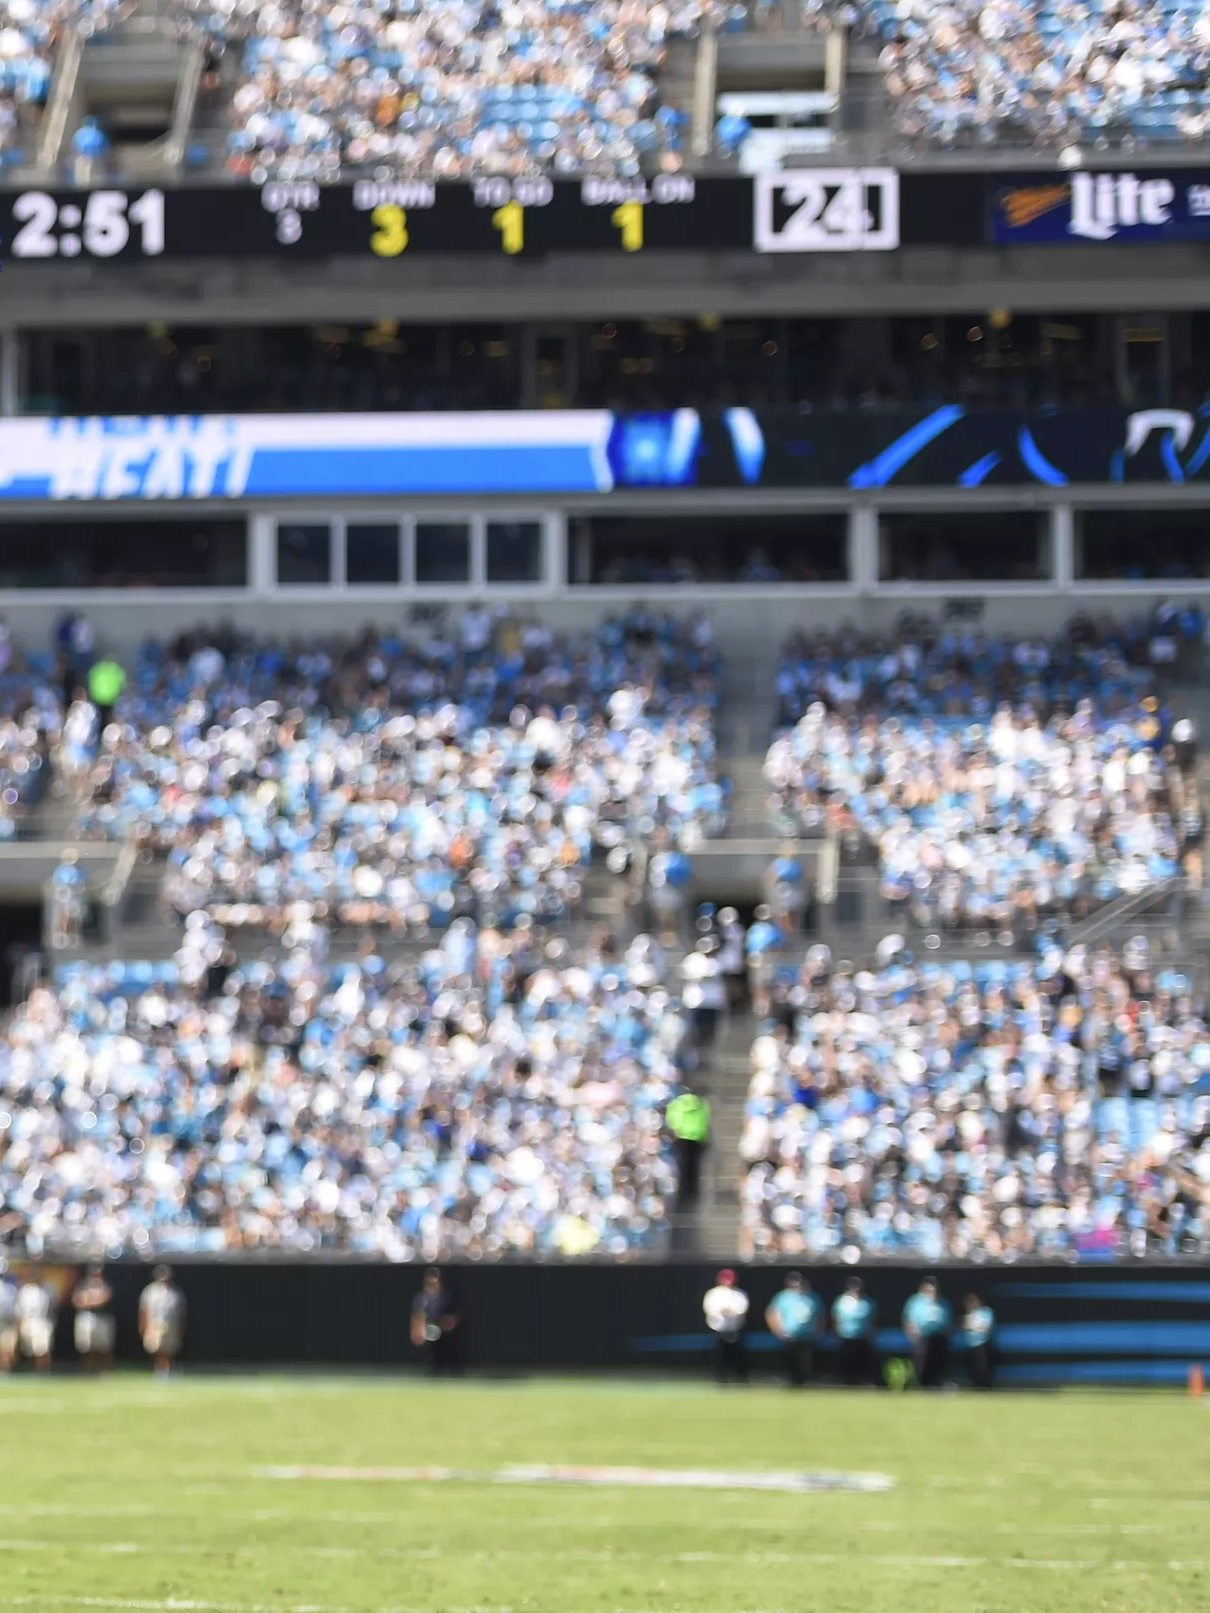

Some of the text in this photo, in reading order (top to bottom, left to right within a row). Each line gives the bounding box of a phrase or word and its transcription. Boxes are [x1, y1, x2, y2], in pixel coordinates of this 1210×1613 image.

[10, 189, 166, 259] 2:51
[370, 203, 409, 257] 3
[492, 199, 524, 254] 1
[612, 199, 643, 252] 1
[1067, 171, 1176, 240] Lite
